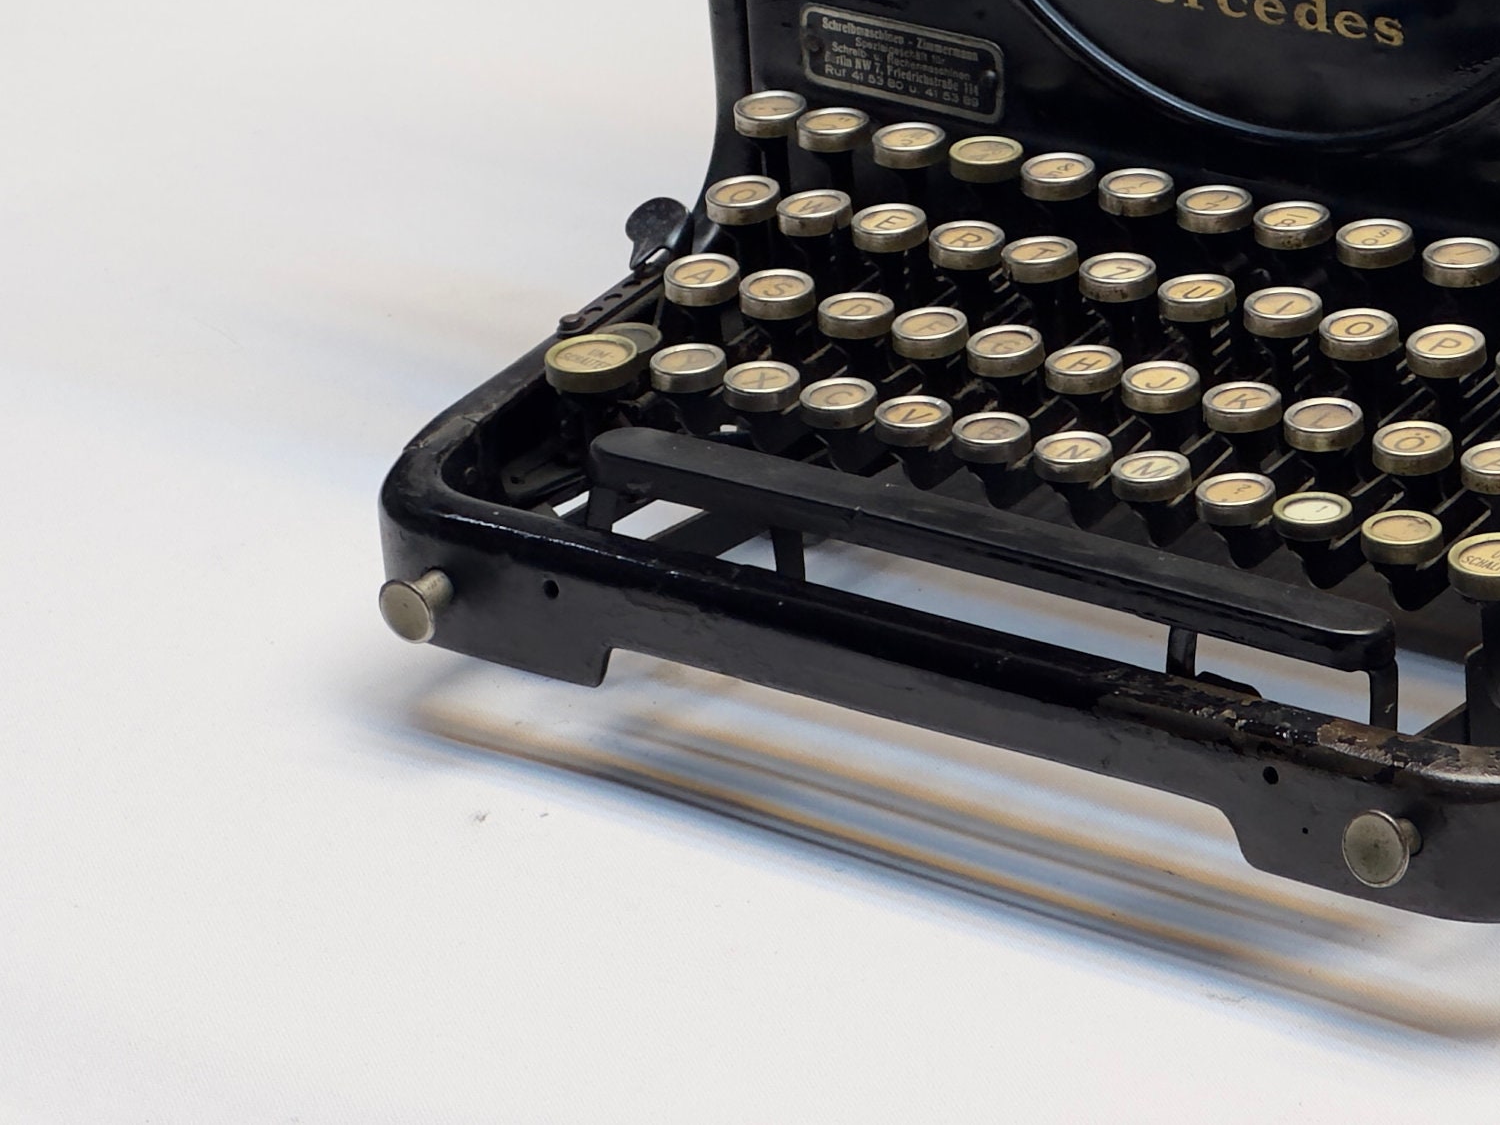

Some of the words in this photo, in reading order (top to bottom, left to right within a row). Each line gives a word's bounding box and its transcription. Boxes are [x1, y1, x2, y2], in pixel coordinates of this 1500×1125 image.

[825, 51, 853, 68] Brlin
[874, 215, 908, 231] E
[949, 232, 983, 247] R
[1032, 247, 1057, 260] T
[682, 267, 717, 284] A
[762, 282, 794, 297] S
[1183, 285, 1216, 299] U
[842, 303, 873, 316] D
[916, 320, 948, 334] F
[1344, 321, 1374, 335] O
[1428, 337, 1462, 352] P
[1066, 357, 1102, 371] H
[742, 372, 779, 390] X
[1145, 377, 1177, 390] J
[825, 391, 855, 406] C
[1224, 393, 1258, 409] K
[901, 408, 933, 422] V
[1393, 432, 1431, 451] Ö
[1057, 445, 1091, 458] N
[1136, 462, 1173, 477] M
